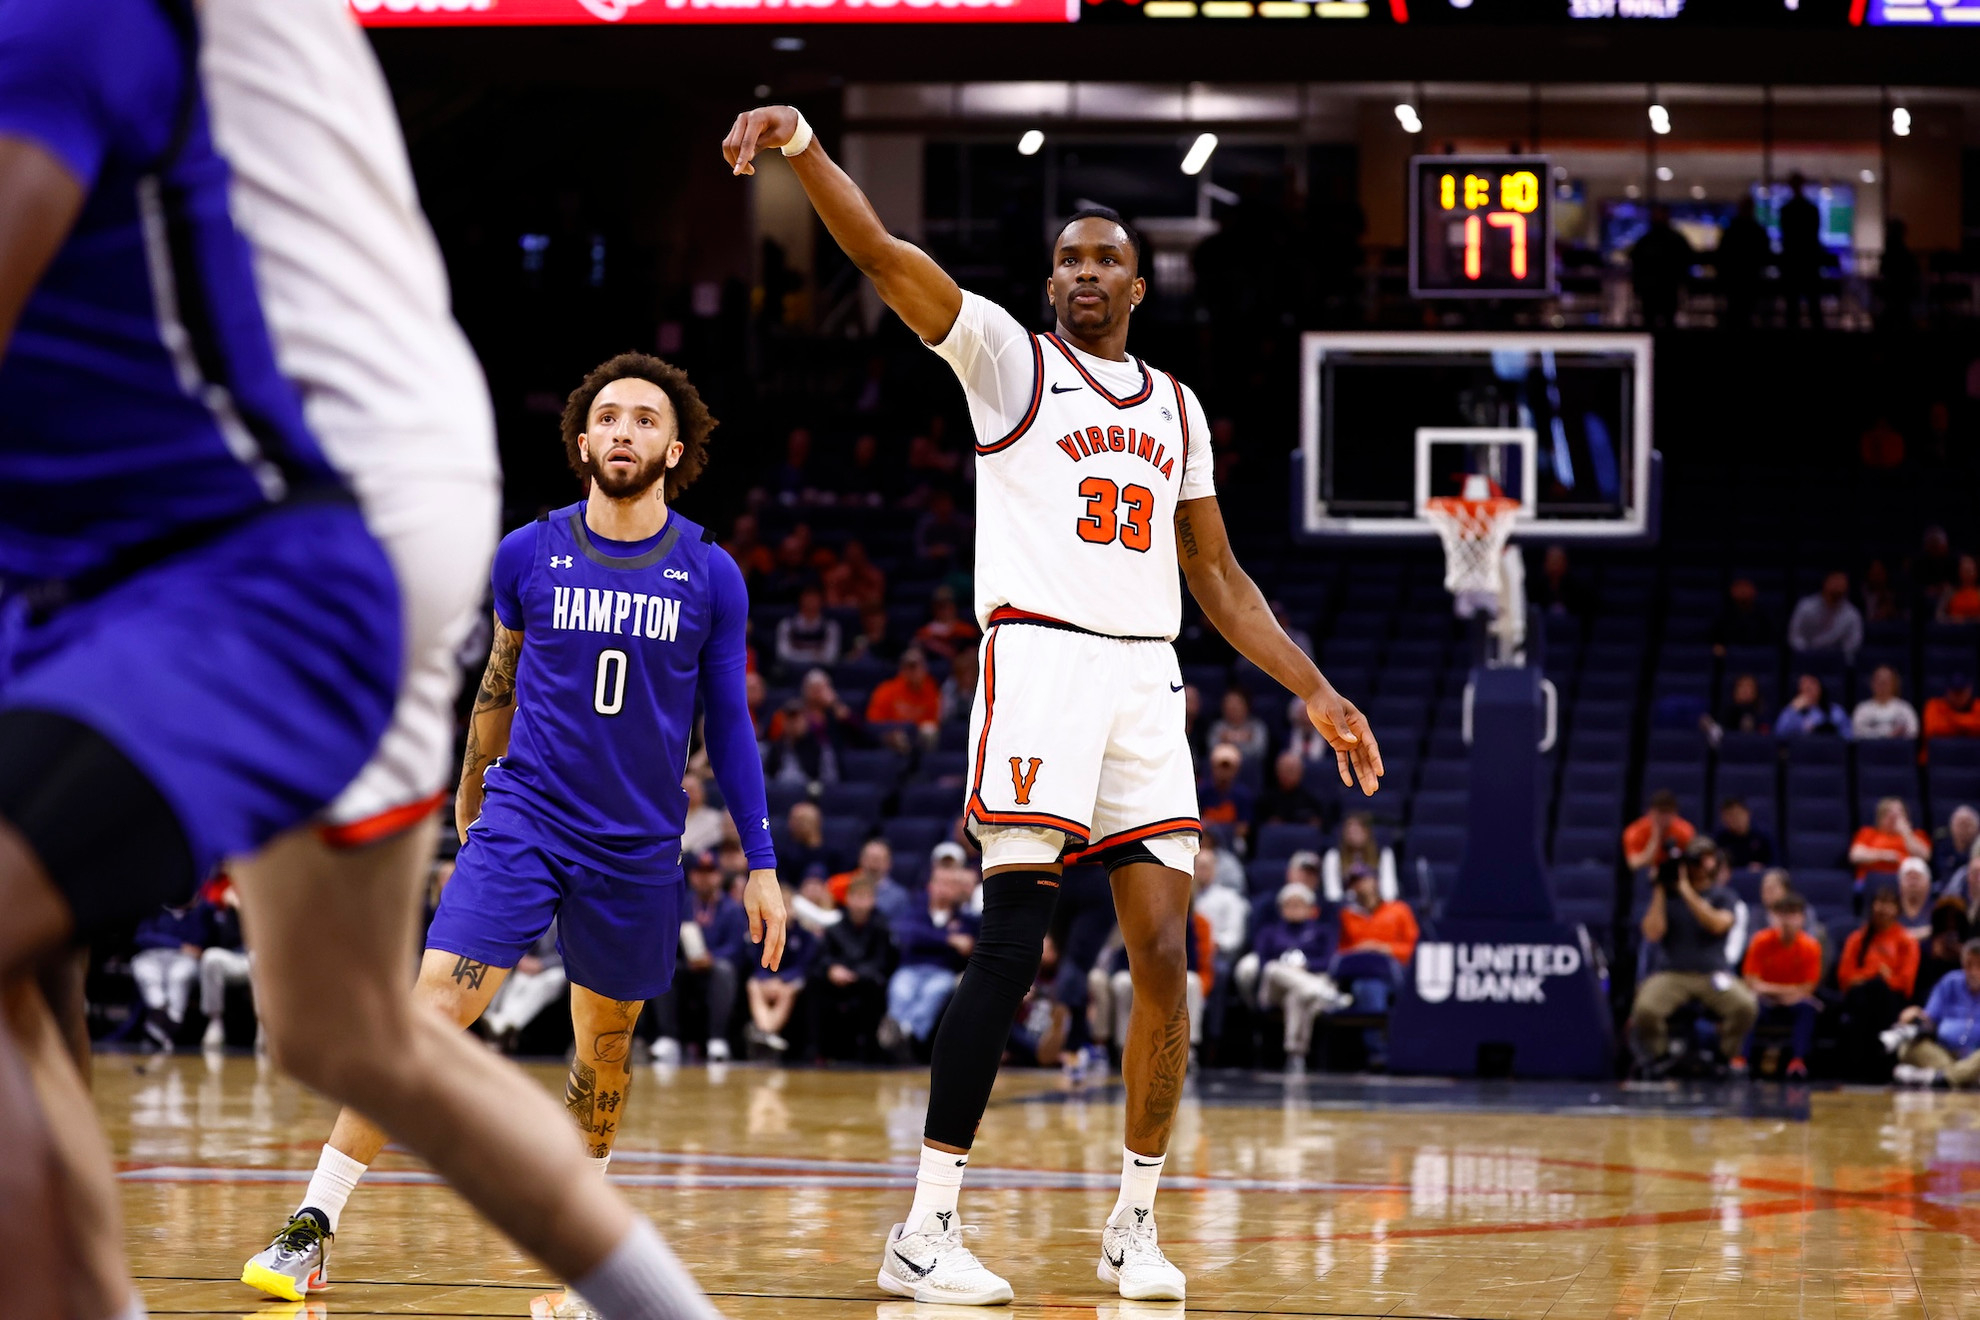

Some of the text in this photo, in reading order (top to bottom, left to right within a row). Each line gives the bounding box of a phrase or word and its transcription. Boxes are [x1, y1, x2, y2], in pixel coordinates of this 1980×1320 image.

[1464, 211, 1528, 280] 17
[1056, 425, 1175, 481] VIRGINIA
[1076, 476, 1155, 554] 33
[662, 568, 689, 582] CAA
[552, 586, 682, 643] HAMPTON
[594, 648, 628, 717] 0
[1008, 756, 1043, 805] V
[1456, 942, 1581, 976] UNITED
[1456, 973, 1546, 1004] BANK
